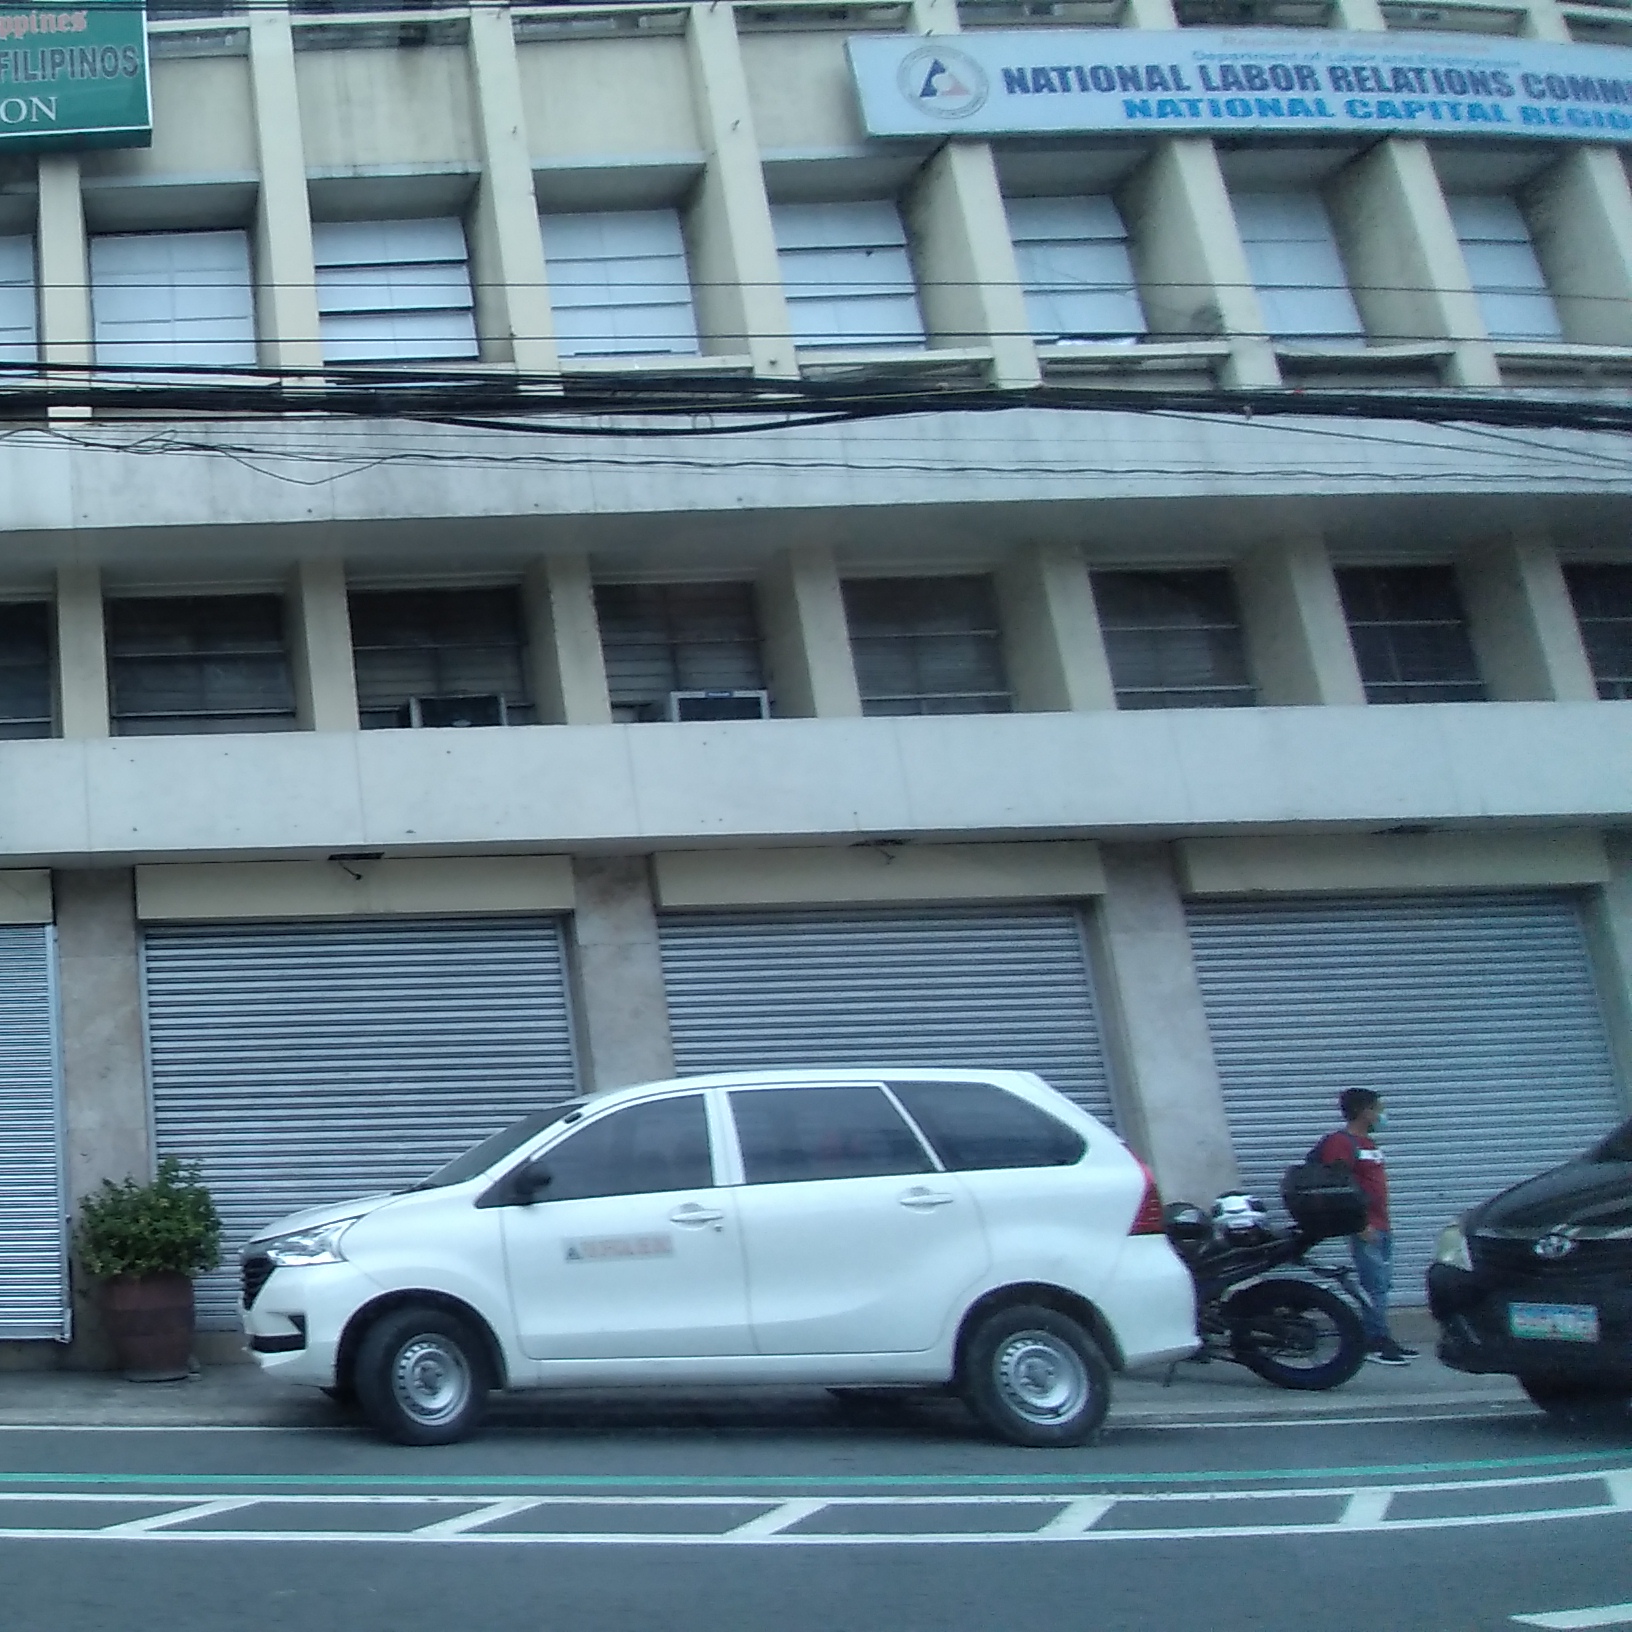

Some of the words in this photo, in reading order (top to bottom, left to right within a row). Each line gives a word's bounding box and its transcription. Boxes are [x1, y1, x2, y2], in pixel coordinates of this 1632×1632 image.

[1000, 63, 1192, 95] NATIONAL
[1199, 63, 1322, 93] LABOR
[1326, 65, 1516, 98] RELATIONS
[1121, 98, 1336, 120] NATIONAL
[1344, 98, 1512, 124] CAPITAL
